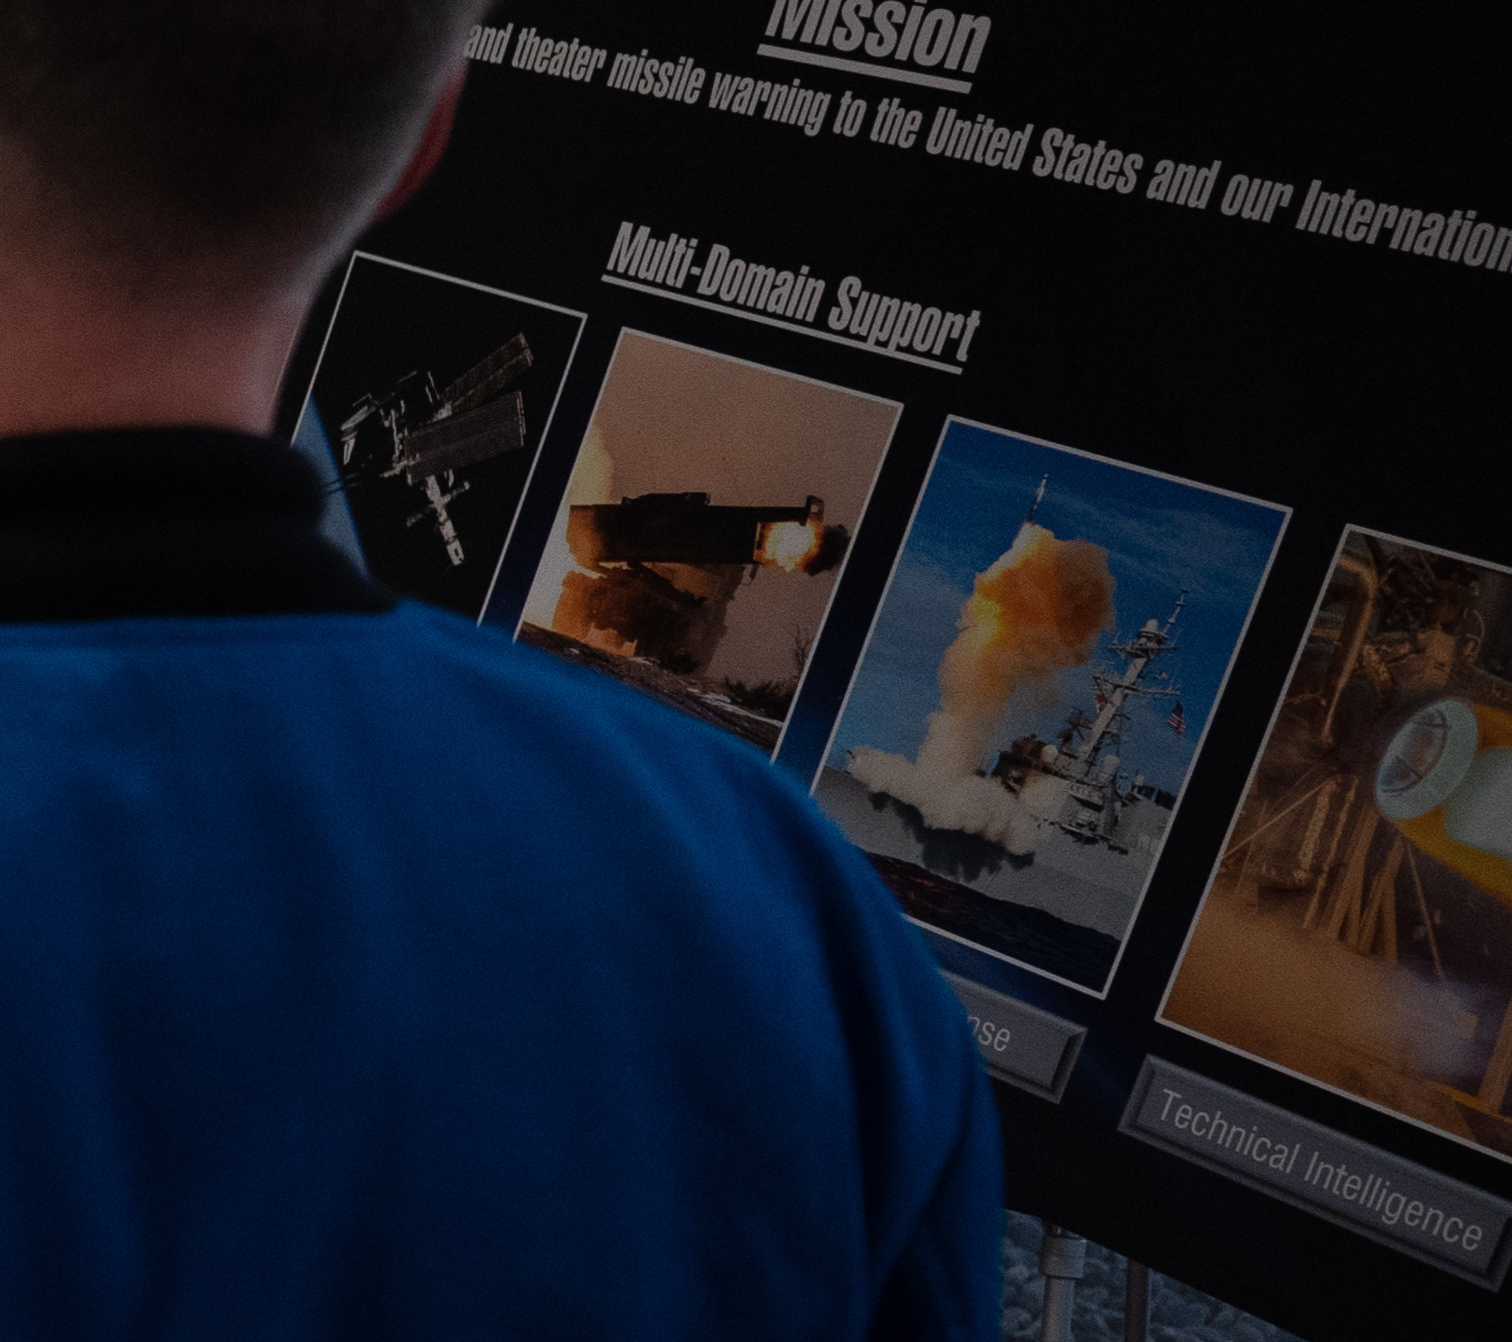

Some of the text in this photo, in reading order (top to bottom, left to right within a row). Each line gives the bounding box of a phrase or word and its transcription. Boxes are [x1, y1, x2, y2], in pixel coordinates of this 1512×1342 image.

[463, 22, 1512, 275] and theater missile warning to the United States and our Internation
[606, 220, 983, 364] Multi-Domain Support
[1158, 1088, 1486, 1256] Technical Intelligence
